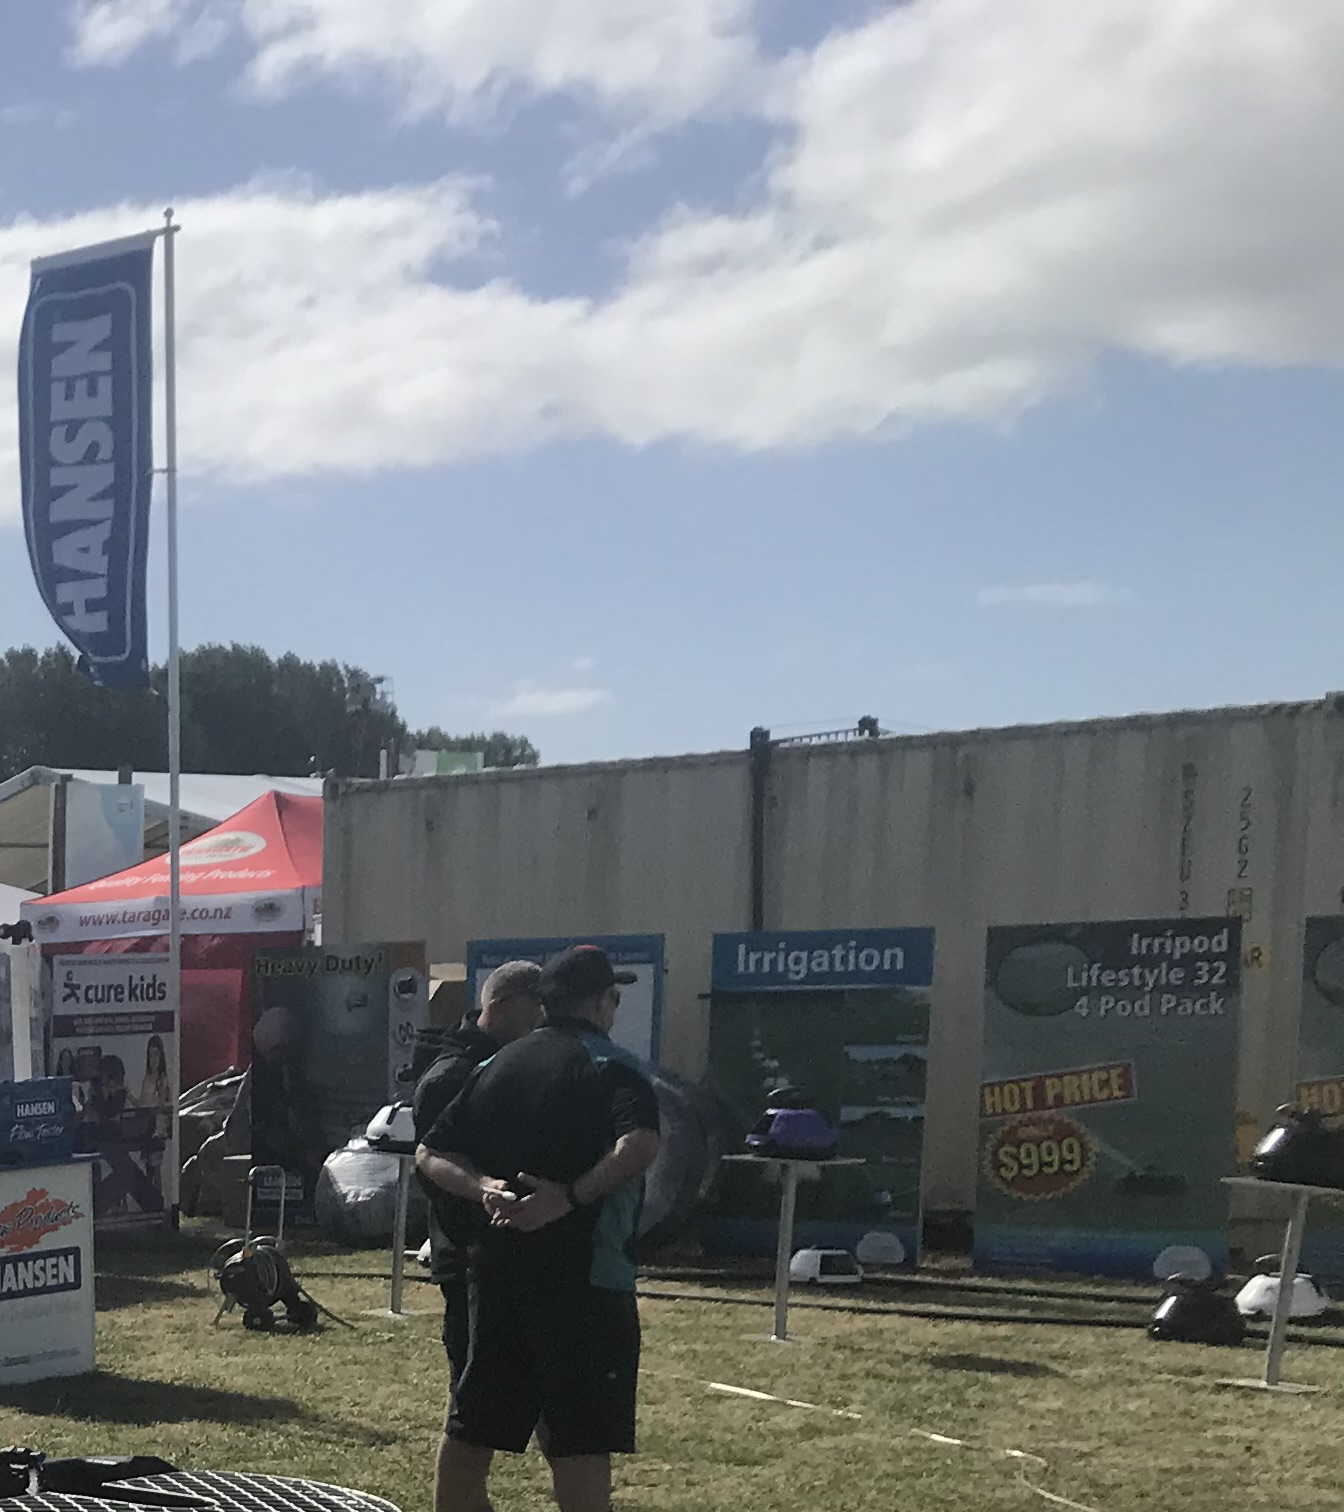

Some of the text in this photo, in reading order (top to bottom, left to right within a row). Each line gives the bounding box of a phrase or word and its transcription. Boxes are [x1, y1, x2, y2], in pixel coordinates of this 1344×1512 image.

[49, 312, 115, 635] HANSEN
[79, 904, 233, 928] www.taragae.co.nz
[1130, 928, 1230, 959] Irripod
[255, 952, 384, 980] Heavy Duty!
[737, 940, 904, 981] Irrigation
[84, 974, 167, 1004] cure kids
[1066, 961, 1228, 991] Lifestyle 32
[1073, 992, 1226, 1018] 4 Pod Pack
[983, 1066, 1126, 1115] HOT PRICE
[17, 1101, 56, 1117] HANSEN
[998, 1136, 1082, 1181] $999
[15, 1201, 80, 1232] Products
